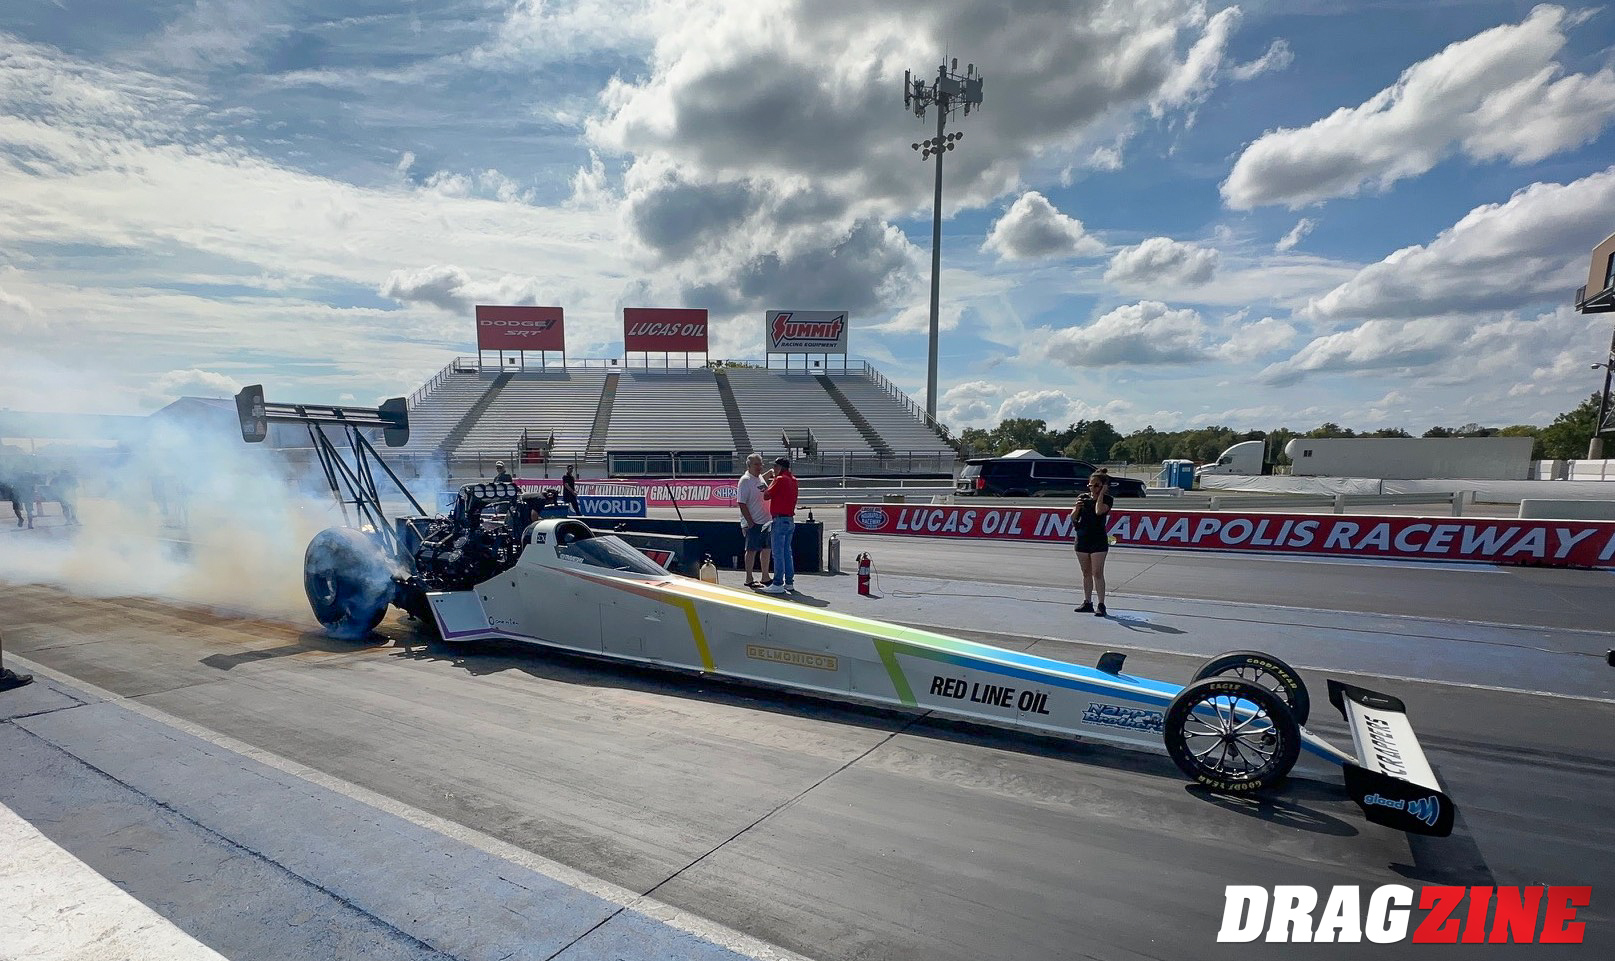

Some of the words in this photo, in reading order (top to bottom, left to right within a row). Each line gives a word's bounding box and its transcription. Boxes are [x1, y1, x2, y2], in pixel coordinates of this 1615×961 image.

[628, 322, 679, 336] LUCAS
[680, 323, 705, 337] OIL
[650, 485, 712, 501] GRANDSTAND
[583, 499, 642, 514] WORLD
[895, 508, 975, 534] LUCAS
[981, 511, 1022, 535] OIL
[1033, 512, 1320, 547] INANAPOLIS
[1323, 521, 1599, 558] RACEWAY
[749, 647, 835, 668] DELMONICO'S
[930, 676, 968, 699] RED
[970, 683, 1016, 708] LINE
[1017, 690, 1050, 715] OIL
[1364, 793, 1405, 810] glaad
